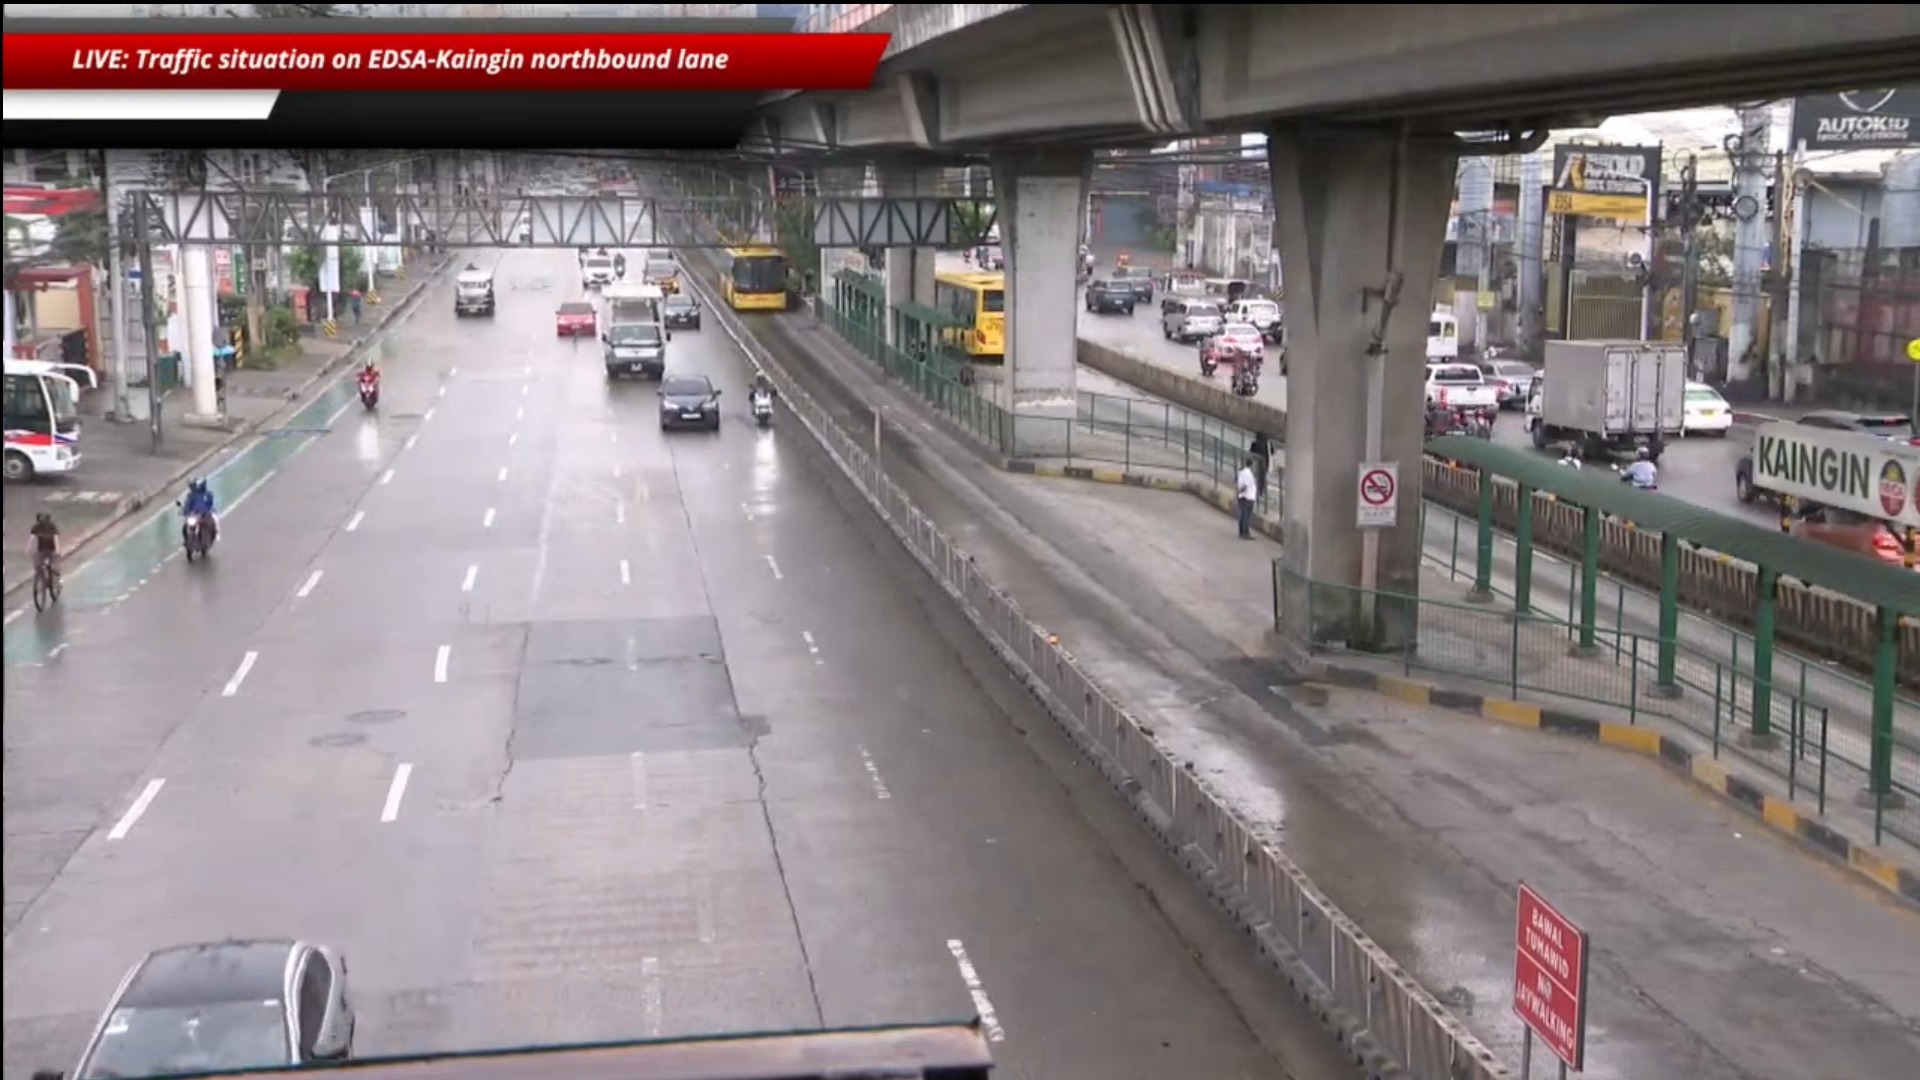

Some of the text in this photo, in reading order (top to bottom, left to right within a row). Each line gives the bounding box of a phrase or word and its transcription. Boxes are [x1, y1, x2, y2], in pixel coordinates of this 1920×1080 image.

[1818, 117, 1910, 132] AUTOKID
[1758, 435, 1871, 499] KAINGIN
[1525, 925, 1570, 980] TUMAWID
[1531, 907, 1564, 950] BAWAL
[1516, 979, 1574, 1050] JAYWALKING
